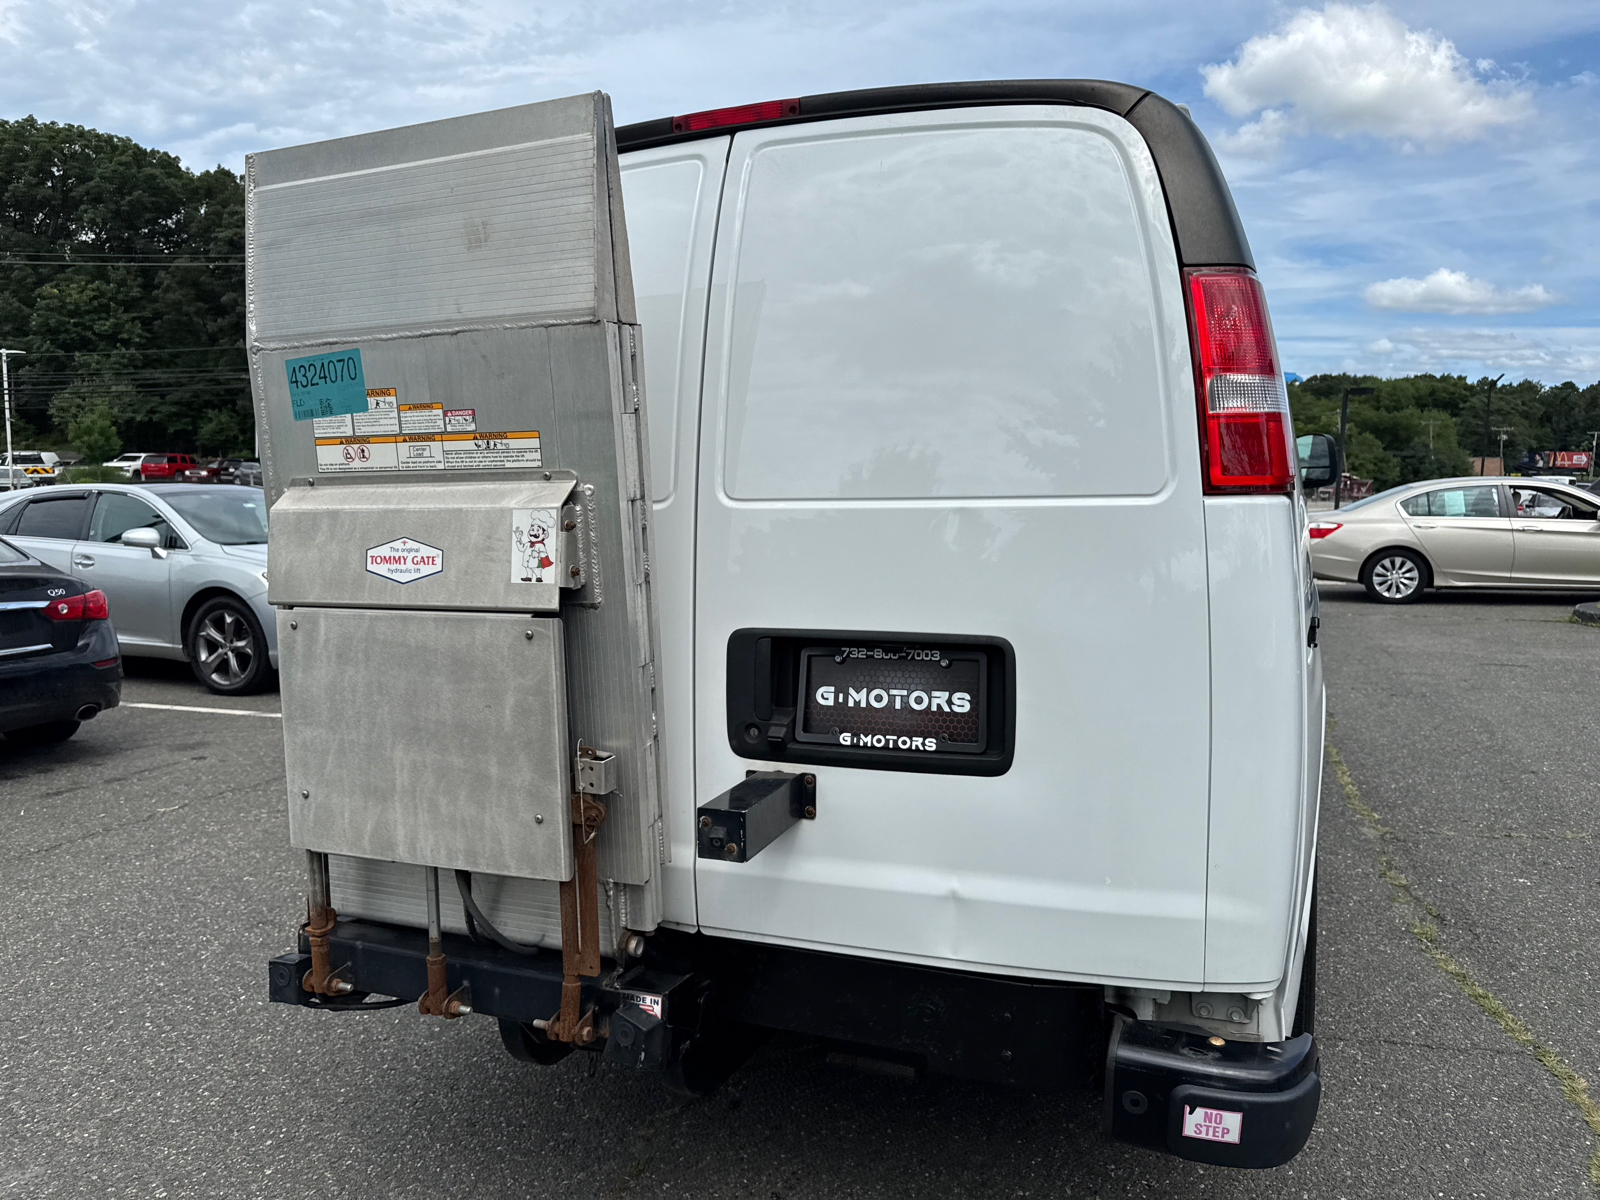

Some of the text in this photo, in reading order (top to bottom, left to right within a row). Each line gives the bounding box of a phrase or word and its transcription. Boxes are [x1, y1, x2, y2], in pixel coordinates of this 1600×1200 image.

[290, 356, 357, 389] 4324070
[366, 389, 391, 397] ARNING
[292, 399, 306, 408] FLD
[370, 556, 437, 565] TOMMY GATE
[48, 588, 66, 597] Q50
[623, 994, 659, 1006] MADE IN
[1203, 1110, 1223, 1125] NO
[1194, 1123, 1230, 1138] STEP
